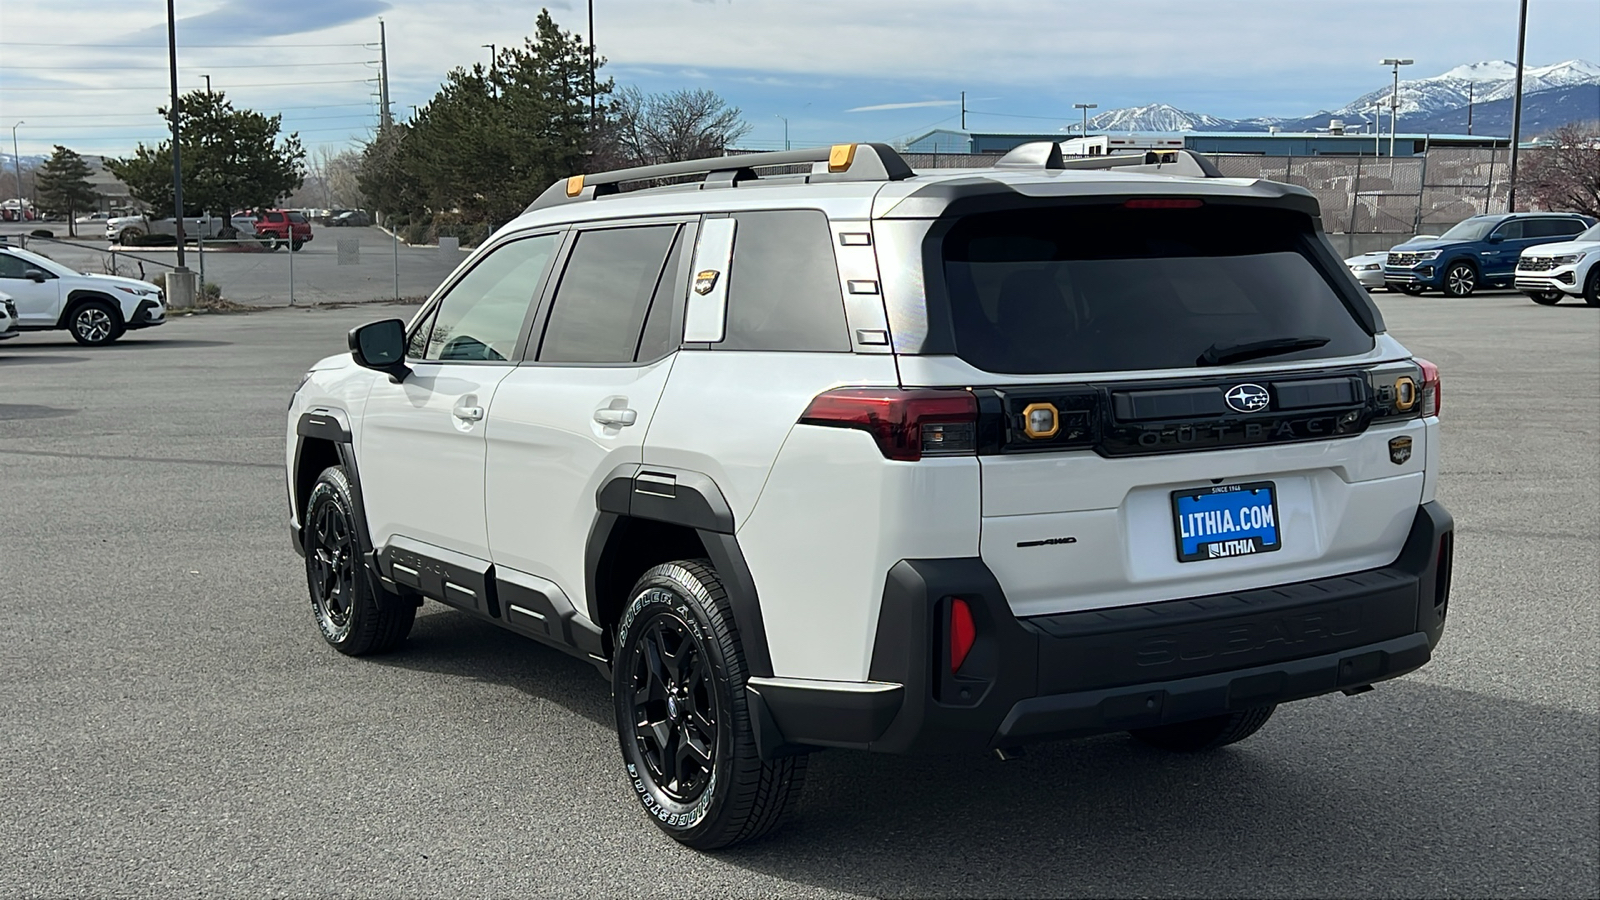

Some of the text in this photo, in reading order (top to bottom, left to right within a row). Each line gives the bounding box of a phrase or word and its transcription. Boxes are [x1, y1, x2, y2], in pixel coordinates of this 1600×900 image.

[1138, 416, 1348, 448] OUTBACK
[1211, 484, 1242, 494] SINCE 1946
[1179, 504, 1275, 538] LITHIA.COM
[1219, 538, 1257, 557] LITHIA
[619, 591, 673, 648] DUELER
[1136, 605, 1362, 667] SUBARU
